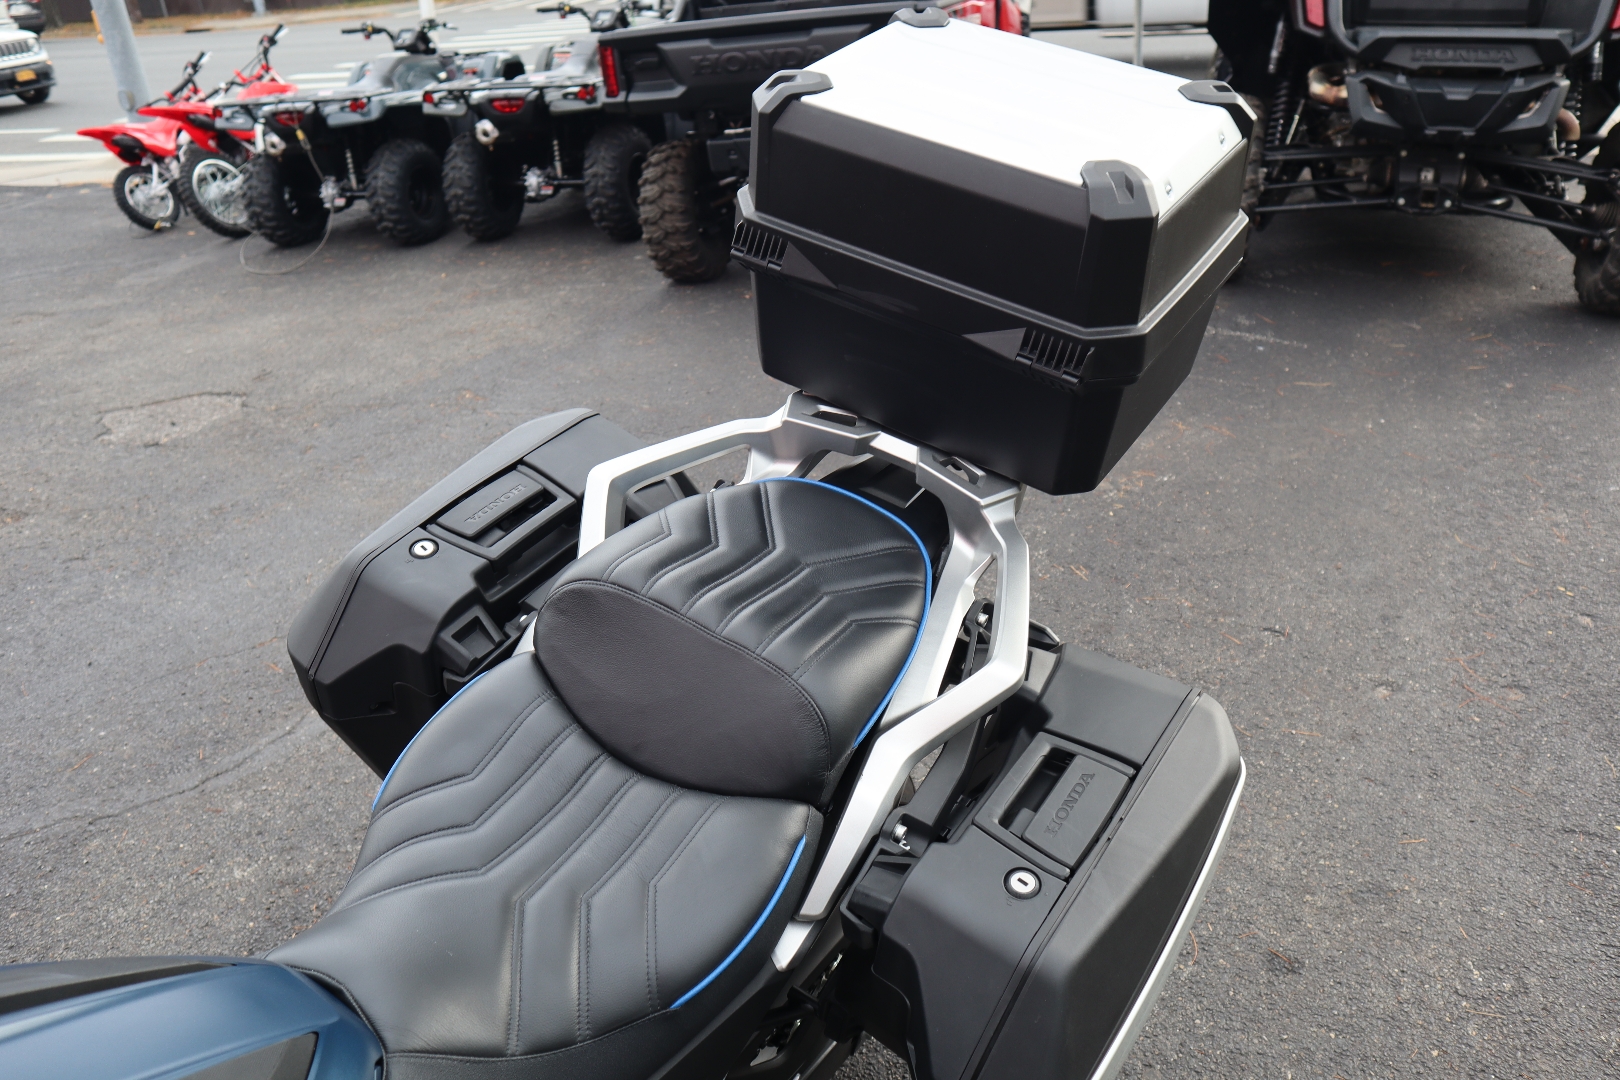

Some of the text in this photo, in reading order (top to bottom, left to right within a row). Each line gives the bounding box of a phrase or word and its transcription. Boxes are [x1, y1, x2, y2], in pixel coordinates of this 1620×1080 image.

[690, 44, 828, 76] HONDA
[1410, 46, 1518, 64] HONDA
[463, 483, 528, 524] HONDA
[1043, 771, 1096, 838] HONDA
